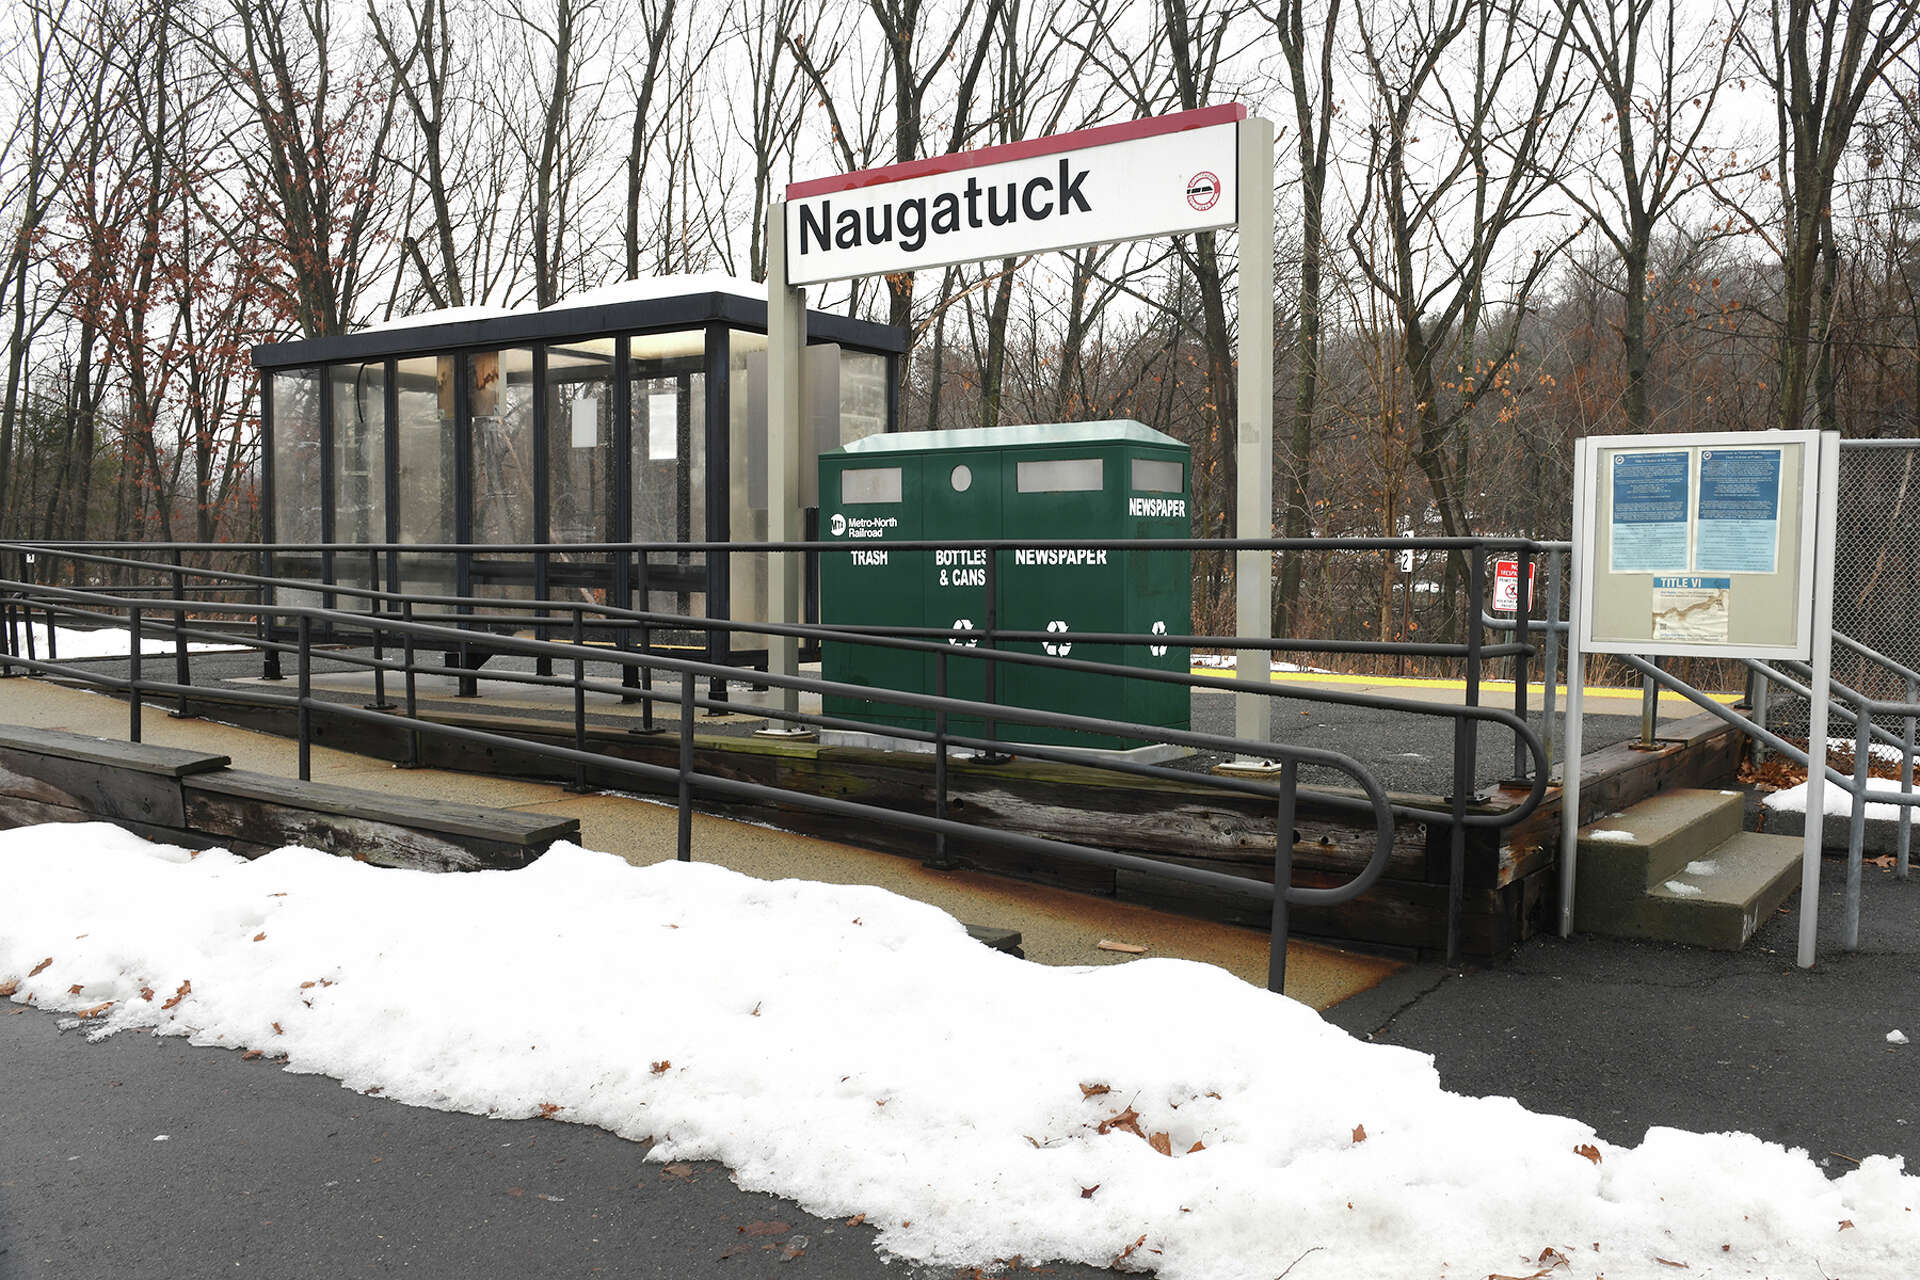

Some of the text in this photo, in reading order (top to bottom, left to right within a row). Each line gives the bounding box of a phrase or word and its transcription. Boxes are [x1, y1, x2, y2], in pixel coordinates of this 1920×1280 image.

[799, 158, 1092, 255] Naugatuck
[1129, 497, 1186, 518] NEWSPAPER
[848, 517, 898, 528] Metro-North
[848, 527, 883, 538] Railroad
[850, 550, 888, 566] TRASH
[935, 549, 987, 566] BOTTLES
[1015, 549, 1107, 565] NEWSPAPER
[1402, 553, 1409, 570] 2
[939, 568, 986, 586] & CANS
[1660, 577, 1703, 588] TITLE VI
